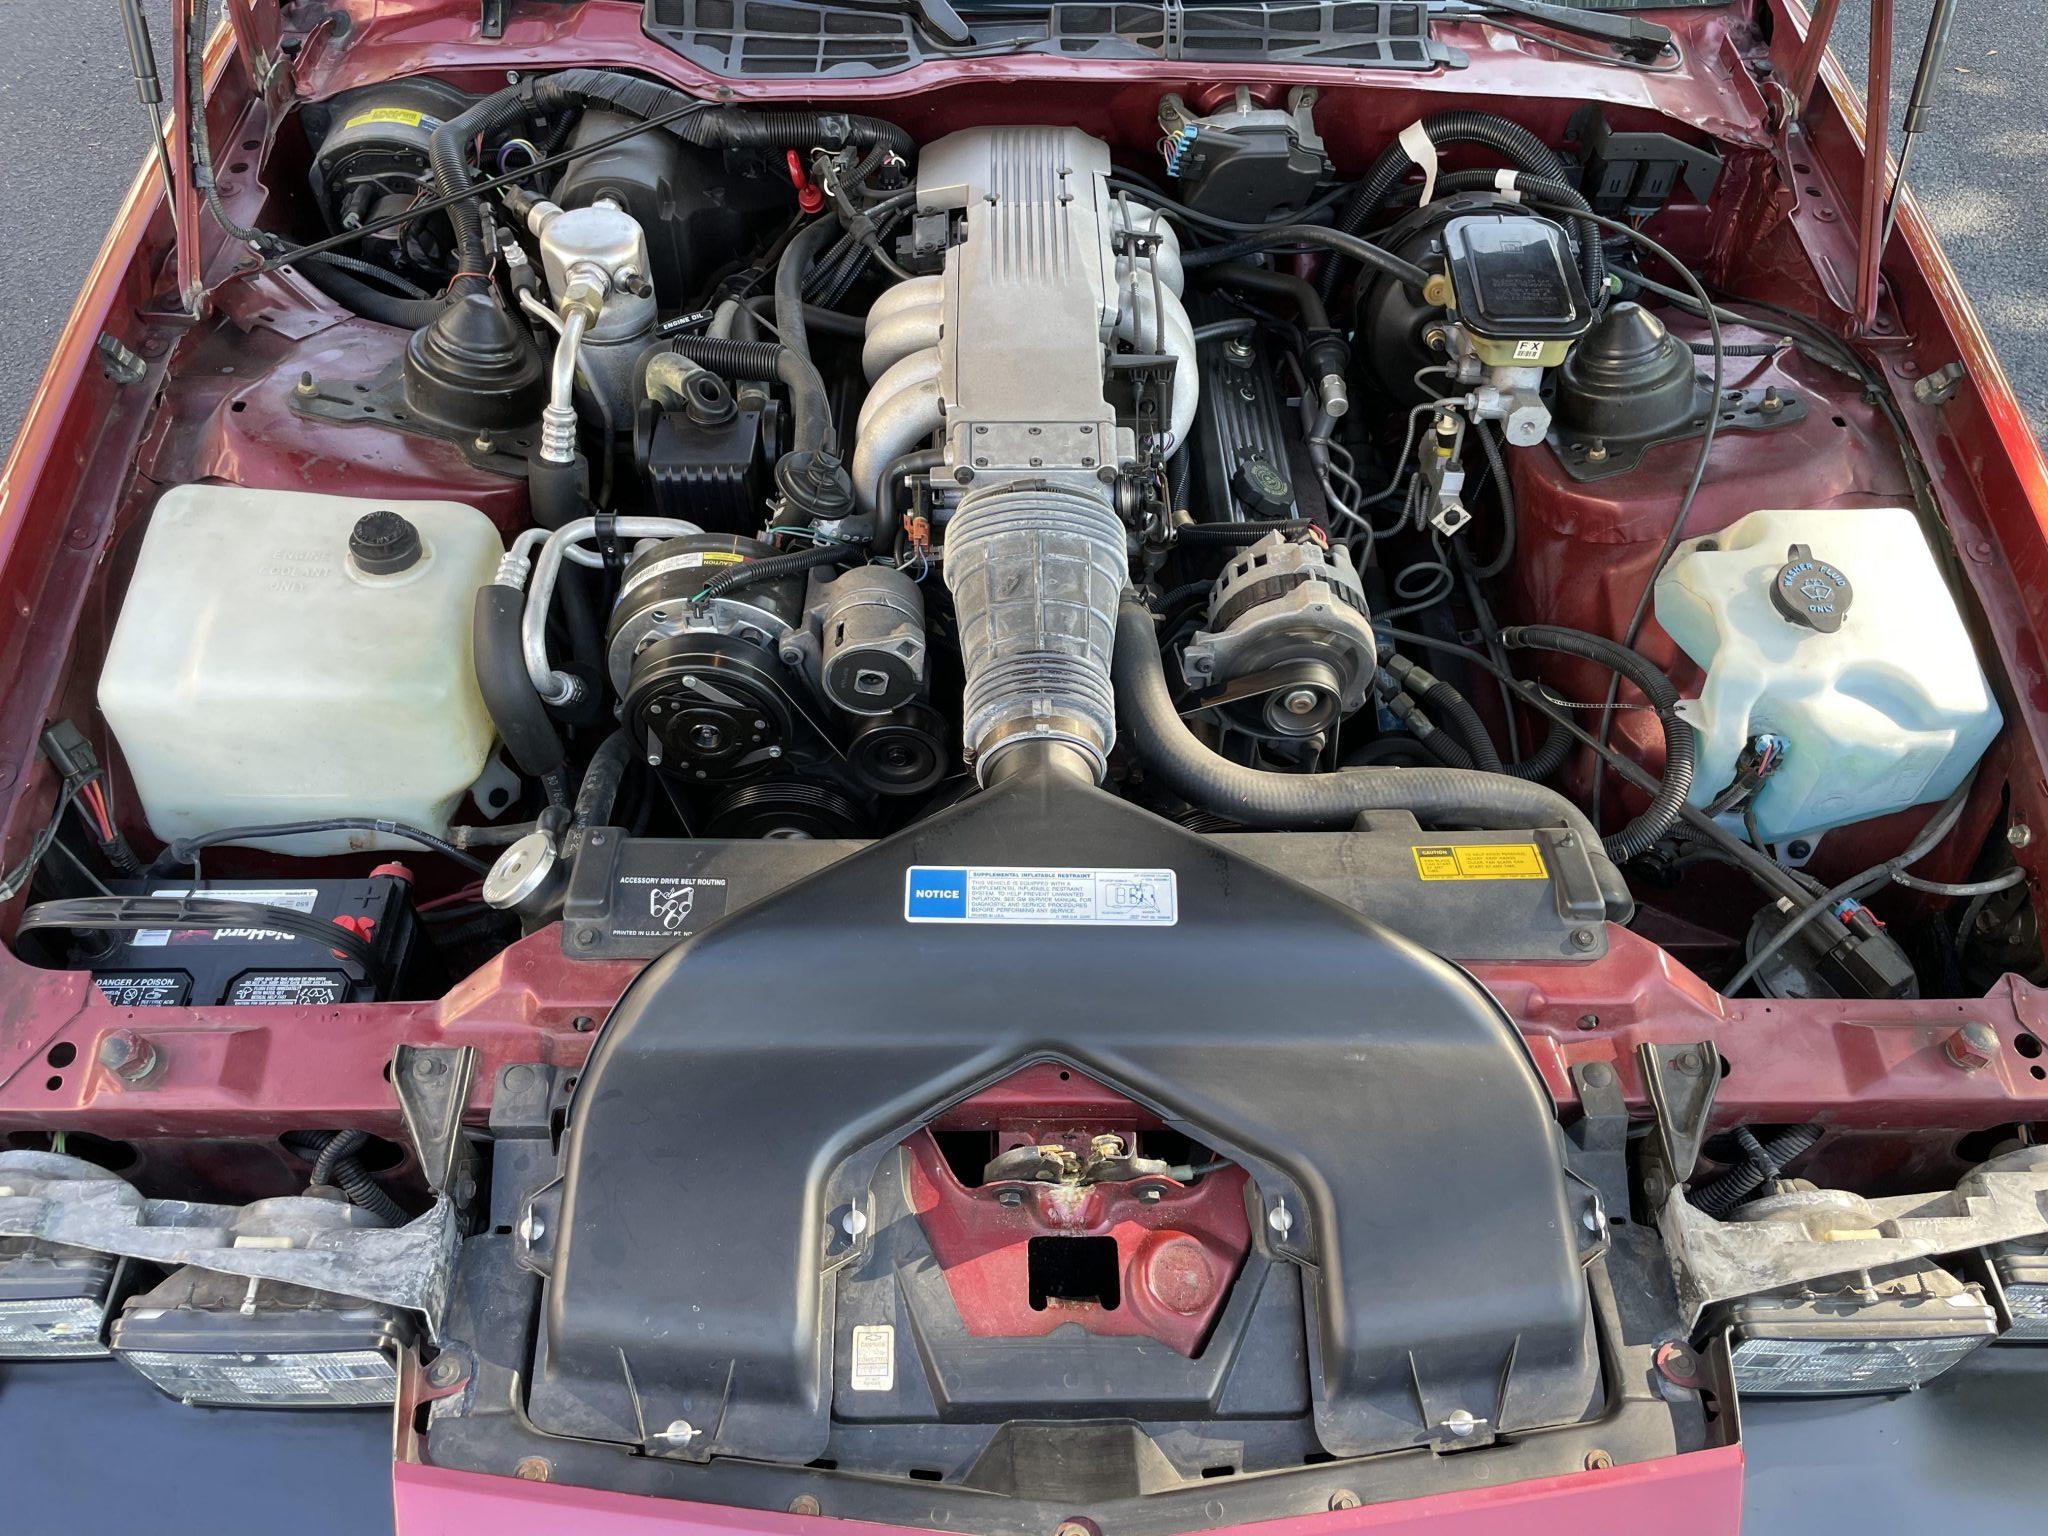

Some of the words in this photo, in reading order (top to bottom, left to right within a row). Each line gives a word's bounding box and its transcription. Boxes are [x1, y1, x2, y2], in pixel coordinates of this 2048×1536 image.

[663, 317, 690, 330] ENGINE
[272, 552, 331, 561] ENGINE
[258, 568, 331, 577] COOLANT
[1784, 562, 1813, 586] WASHER
[1819, 565, 1846, 586] FLUID
[1808, 604, 1834, 612] ONLY
[915, 889, 960, 899] NOTICE
